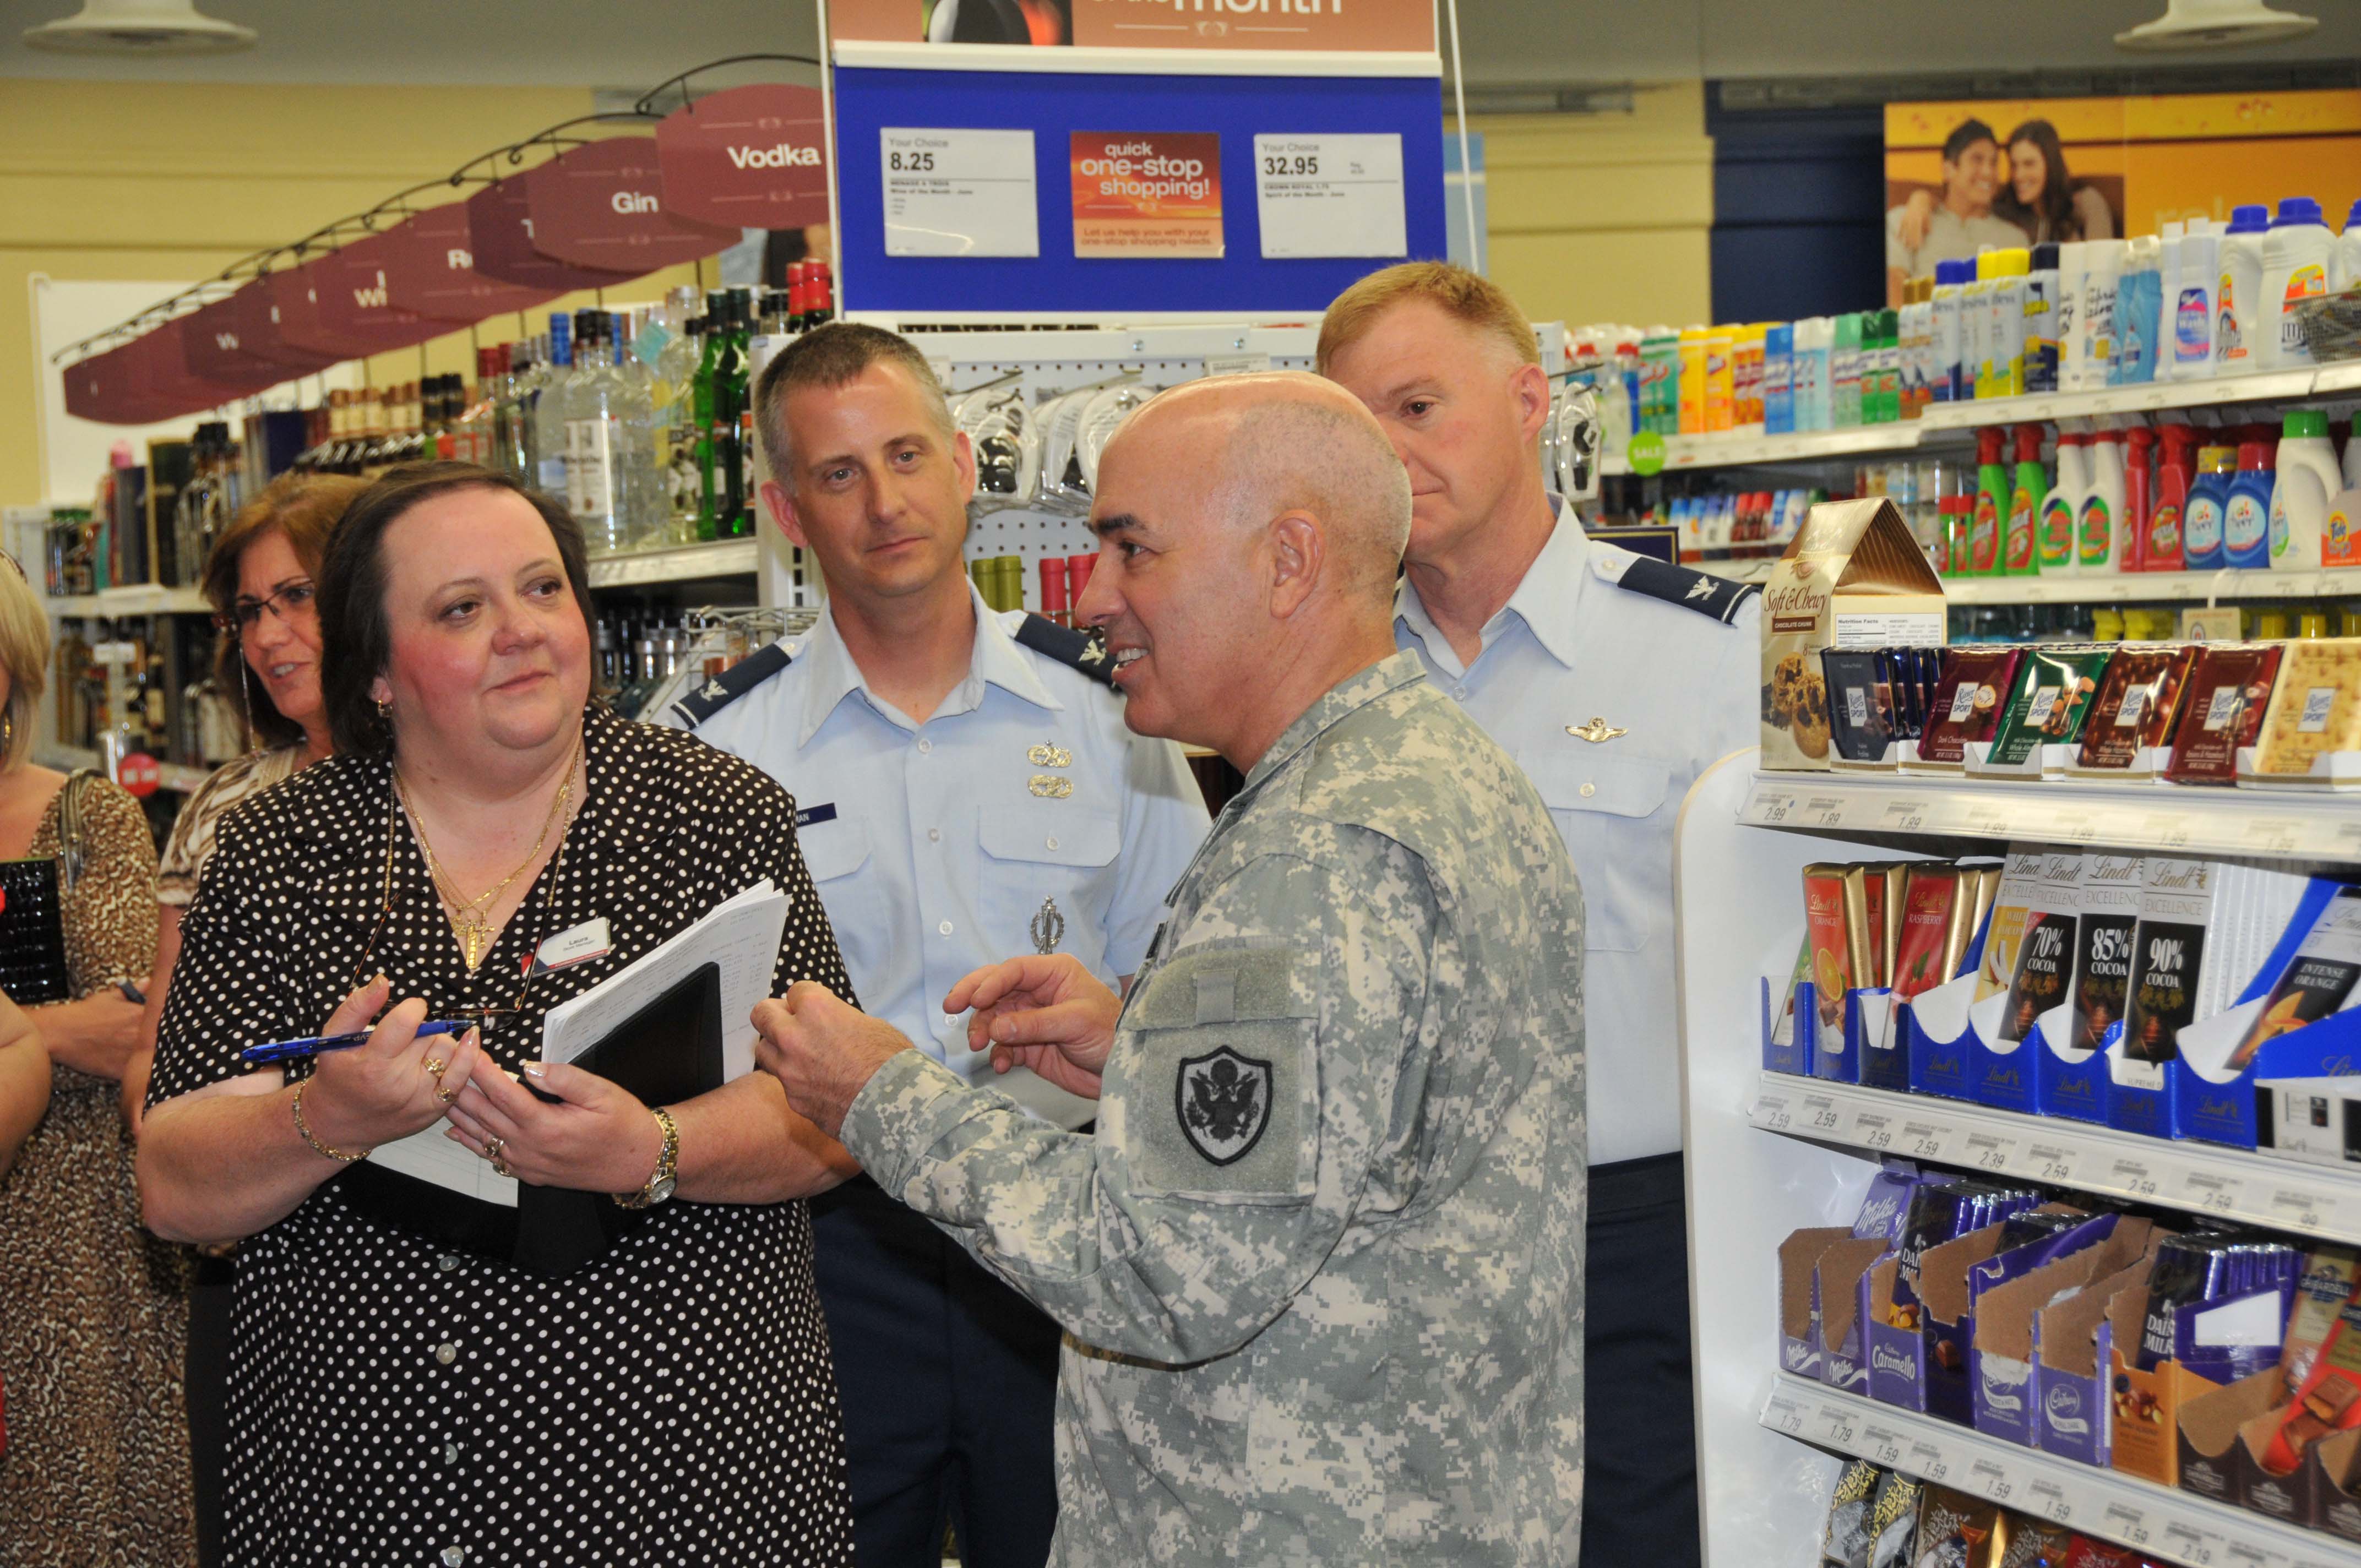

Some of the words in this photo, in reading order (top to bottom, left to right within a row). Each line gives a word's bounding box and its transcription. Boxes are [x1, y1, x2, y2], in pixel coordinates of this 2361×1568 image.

[889, 138, 911, 146] Your
[915, 138, 948, 148] Choice
[1105, 141, 1153, 158] quick
[1287, 143, 1319, 151] Choice
[728, 144, 821, 170] Vodka
[890, 153, 934, 171] 8.25
[1081, 155, 1203, 181] one-stop
[1265, 157, 1318, 175] 32.95
[1100, 178, 1210, 199] shopping!
[612, 192, 658, 214] Gin
[1764, 586, 1786, 619] Soft
[1794, 586, 1827, 617] Chewy
[1851, 709, 1865, 718] SPORT
[1953, 704, 1971, 713] SPORT
[2030, 707, 2050, 717] SPORT
[1765, 807, 1786, 820] 2.99
[1819, 813, 1840, 825] 1.89
[1898, 817, 1921, 829] 1.89
[1982, 823, 2006, 835] 1.89
[2090, 854, 2137, 879] Lindt
[2150, 862, 2195, 889] Lindt
[1810, 894, 1830, 910] Lindt
[2145, 899, 2202, 916] EXCELLENCE
[1815, 916, 1837, 927] ORANGE
[1908, 914, 1943, 925] RASPBERRY
[569, 937, 588, 945] Laura
[2031, 927, 2064, 957] 70%
[2092, 928, 2129, 960] 85%
[2148, 938, 2183, 972] 90%
[2027, 958, 2056, 973] COCOA
[2092, 962, 2126, 976] COCOA
[2300, 963, 2347, 978] INTENSE
[2147, 973, 2179, 988] COCOA
[2294, 974, 2340, 990] ORANGE
[1768, 1112, 1790, 1128] 2.59
[1815, 1112, 1837, 1127] 2.59
[1868, 1131, 1891, 1147] 2.59
[1914, 1140, 1938, 1155] 2.59
[1979, 1151, 2005, 1168] 2.39
[2042, 1163, 2069, 1180] 2.59
[1856, 1196, 1897, 1232] Milka
[1786, 1343, 1808, 1367] Milka
[1873, 1345, 1916, 1380] Caramello
[1829, 1359, 1853, 1383] Milka
[1780, 1414, 1802, 1431] 1.79
[1830, 1424, 1852, 1442] 1.79
[1876, 1444, 1898, 1462] 1.59
[1923, 1461, 1947, 1479] 1.59
[1987, 1480, 2011, 1499] 1.59
[2045, 1501, 2070, 1520] 1.59
[2123, 1526, 2148, 1543] 1.59
